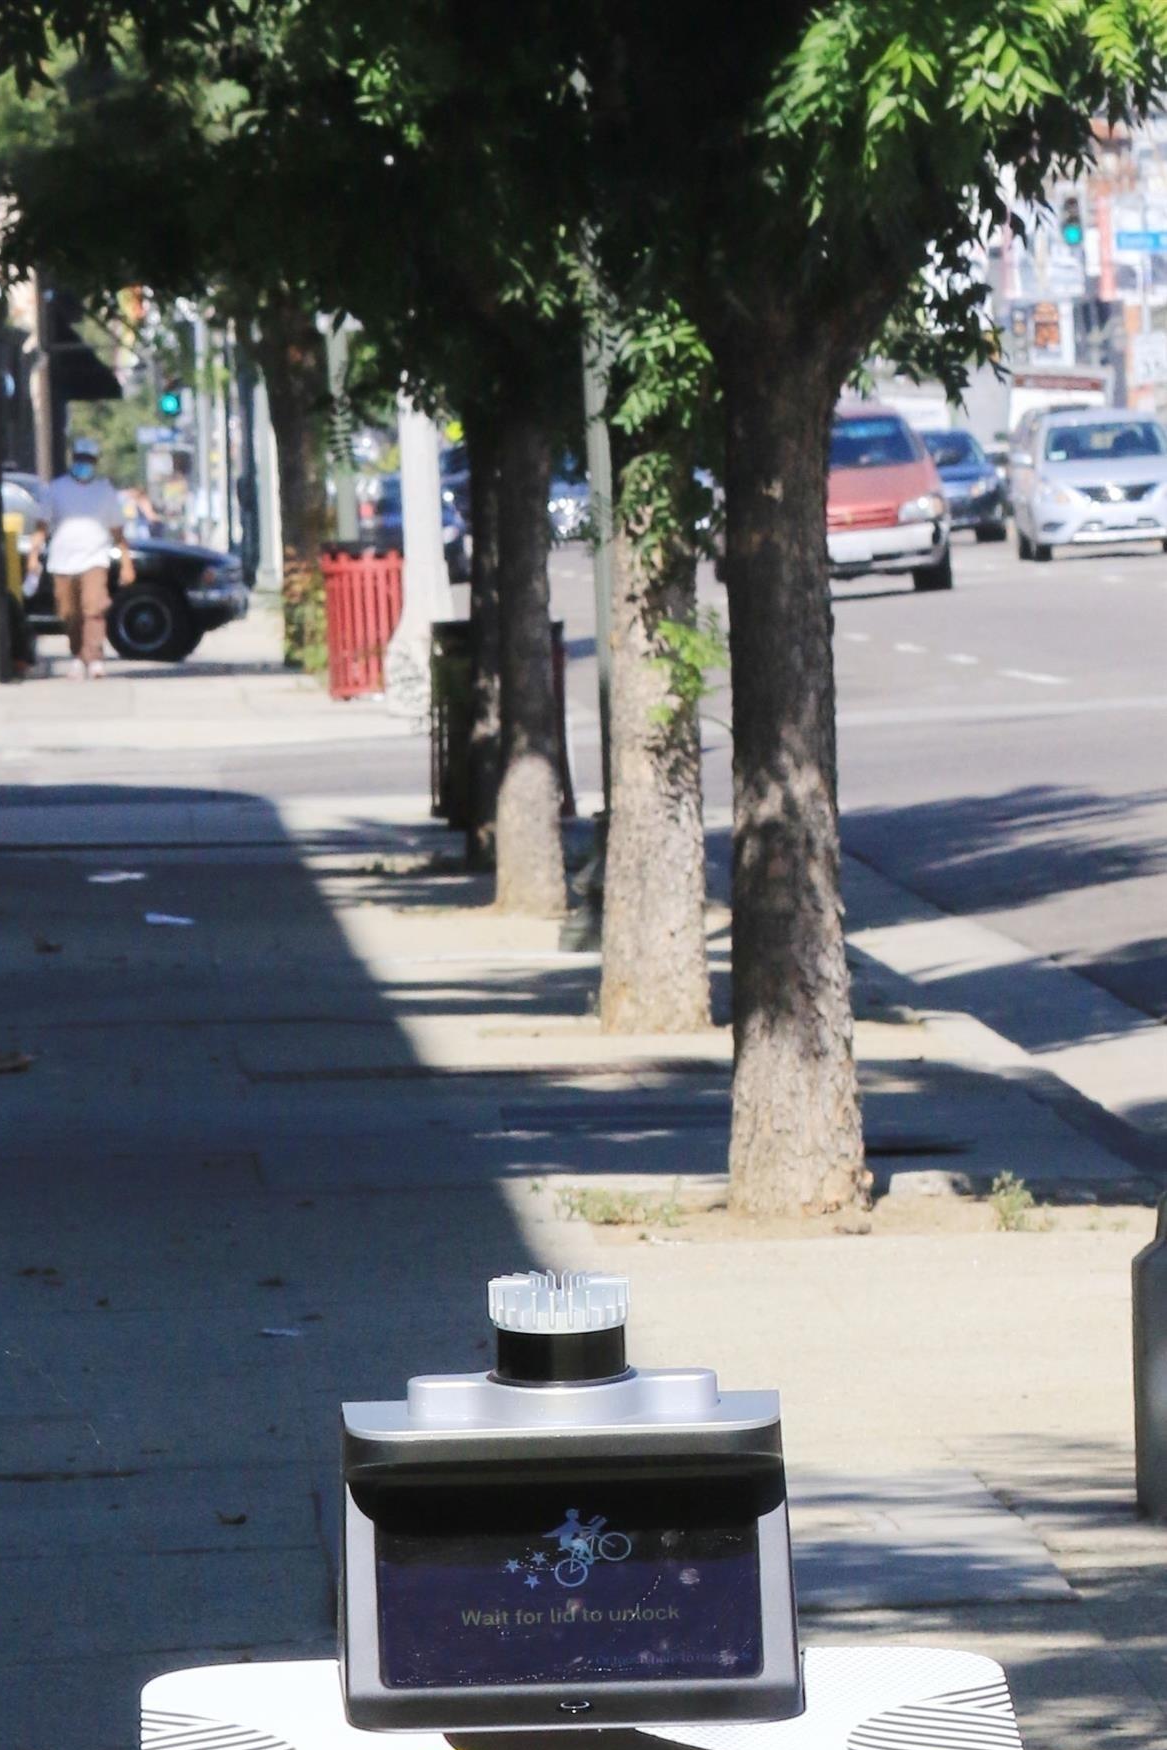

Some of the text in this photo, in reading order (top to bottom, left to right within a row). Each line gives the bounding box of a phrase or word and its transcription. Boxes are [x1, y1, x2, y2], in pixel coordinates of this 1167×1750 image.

[460, 1604, 681, 1627] Wait for lid to unlock
